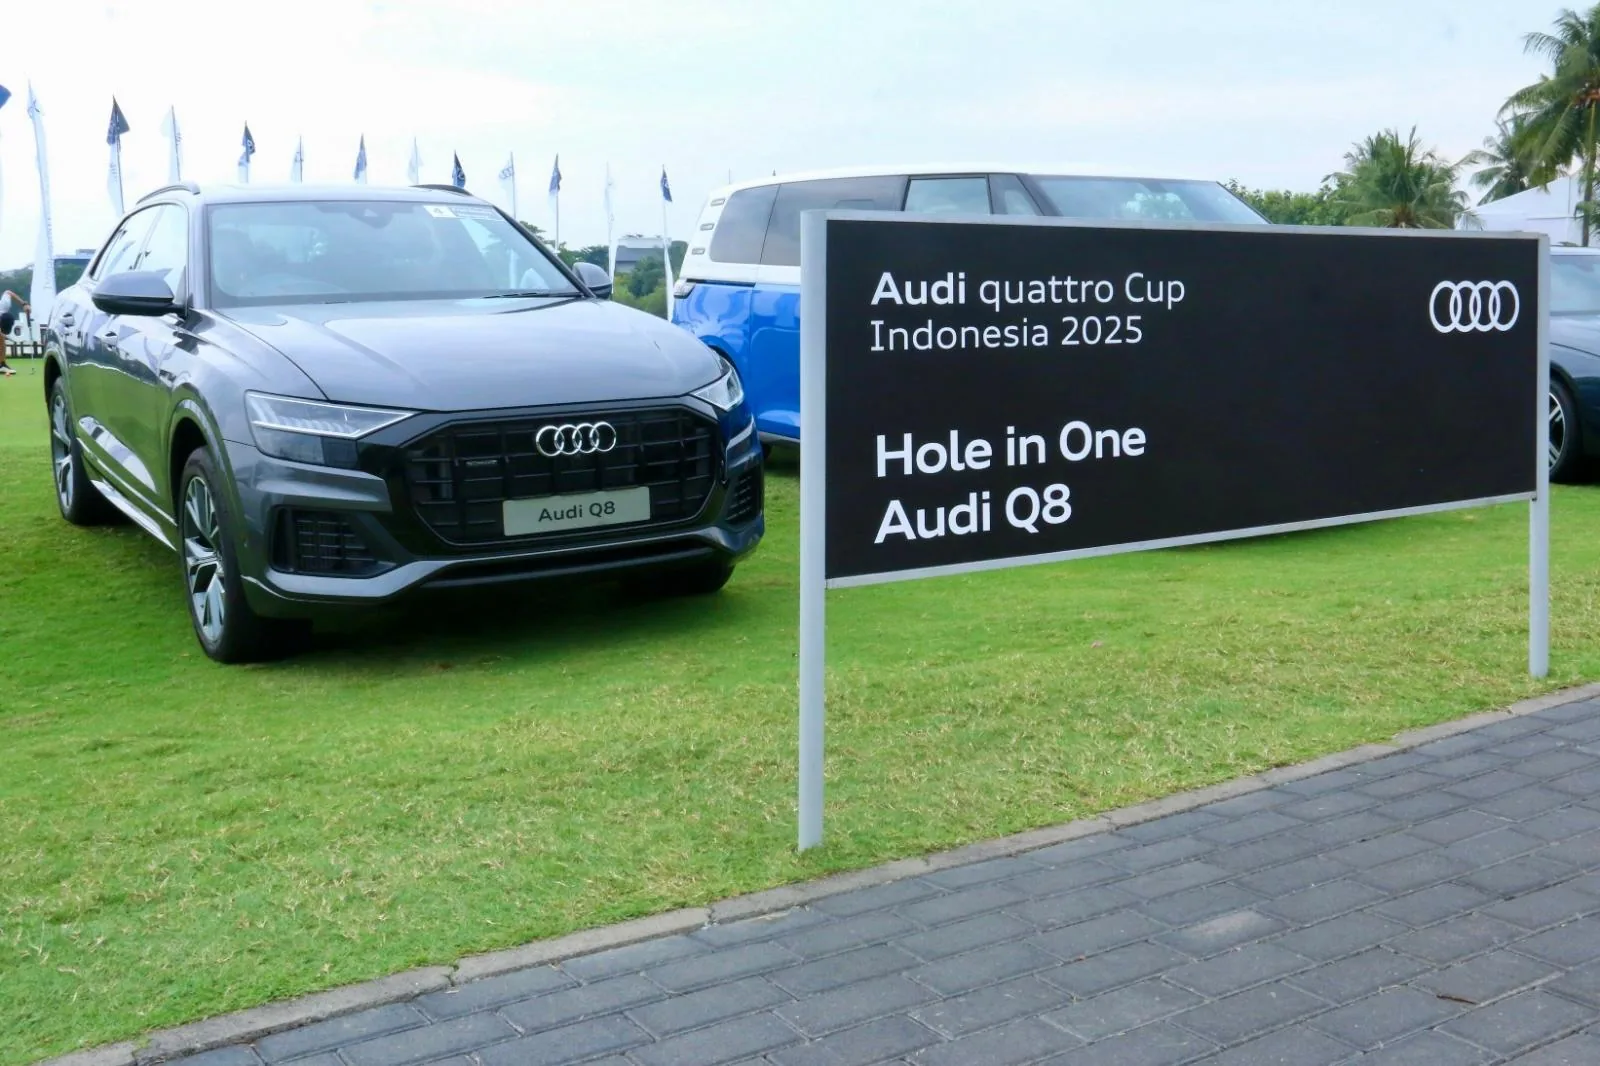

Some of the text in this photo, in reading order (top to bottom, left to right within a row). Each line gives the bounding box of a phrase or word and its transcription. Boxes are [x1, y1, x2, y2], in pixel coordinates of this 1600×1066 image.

[871, 272, 1184, 312] Audi quattro Cup
[871, 315, 1143, 352] Indonesia 2025
[877, 421, 1147, 477] Hole in One
[538, 501, 616, 522] Audi Q8
[874, 484, 1072, 544] Audi Q8
